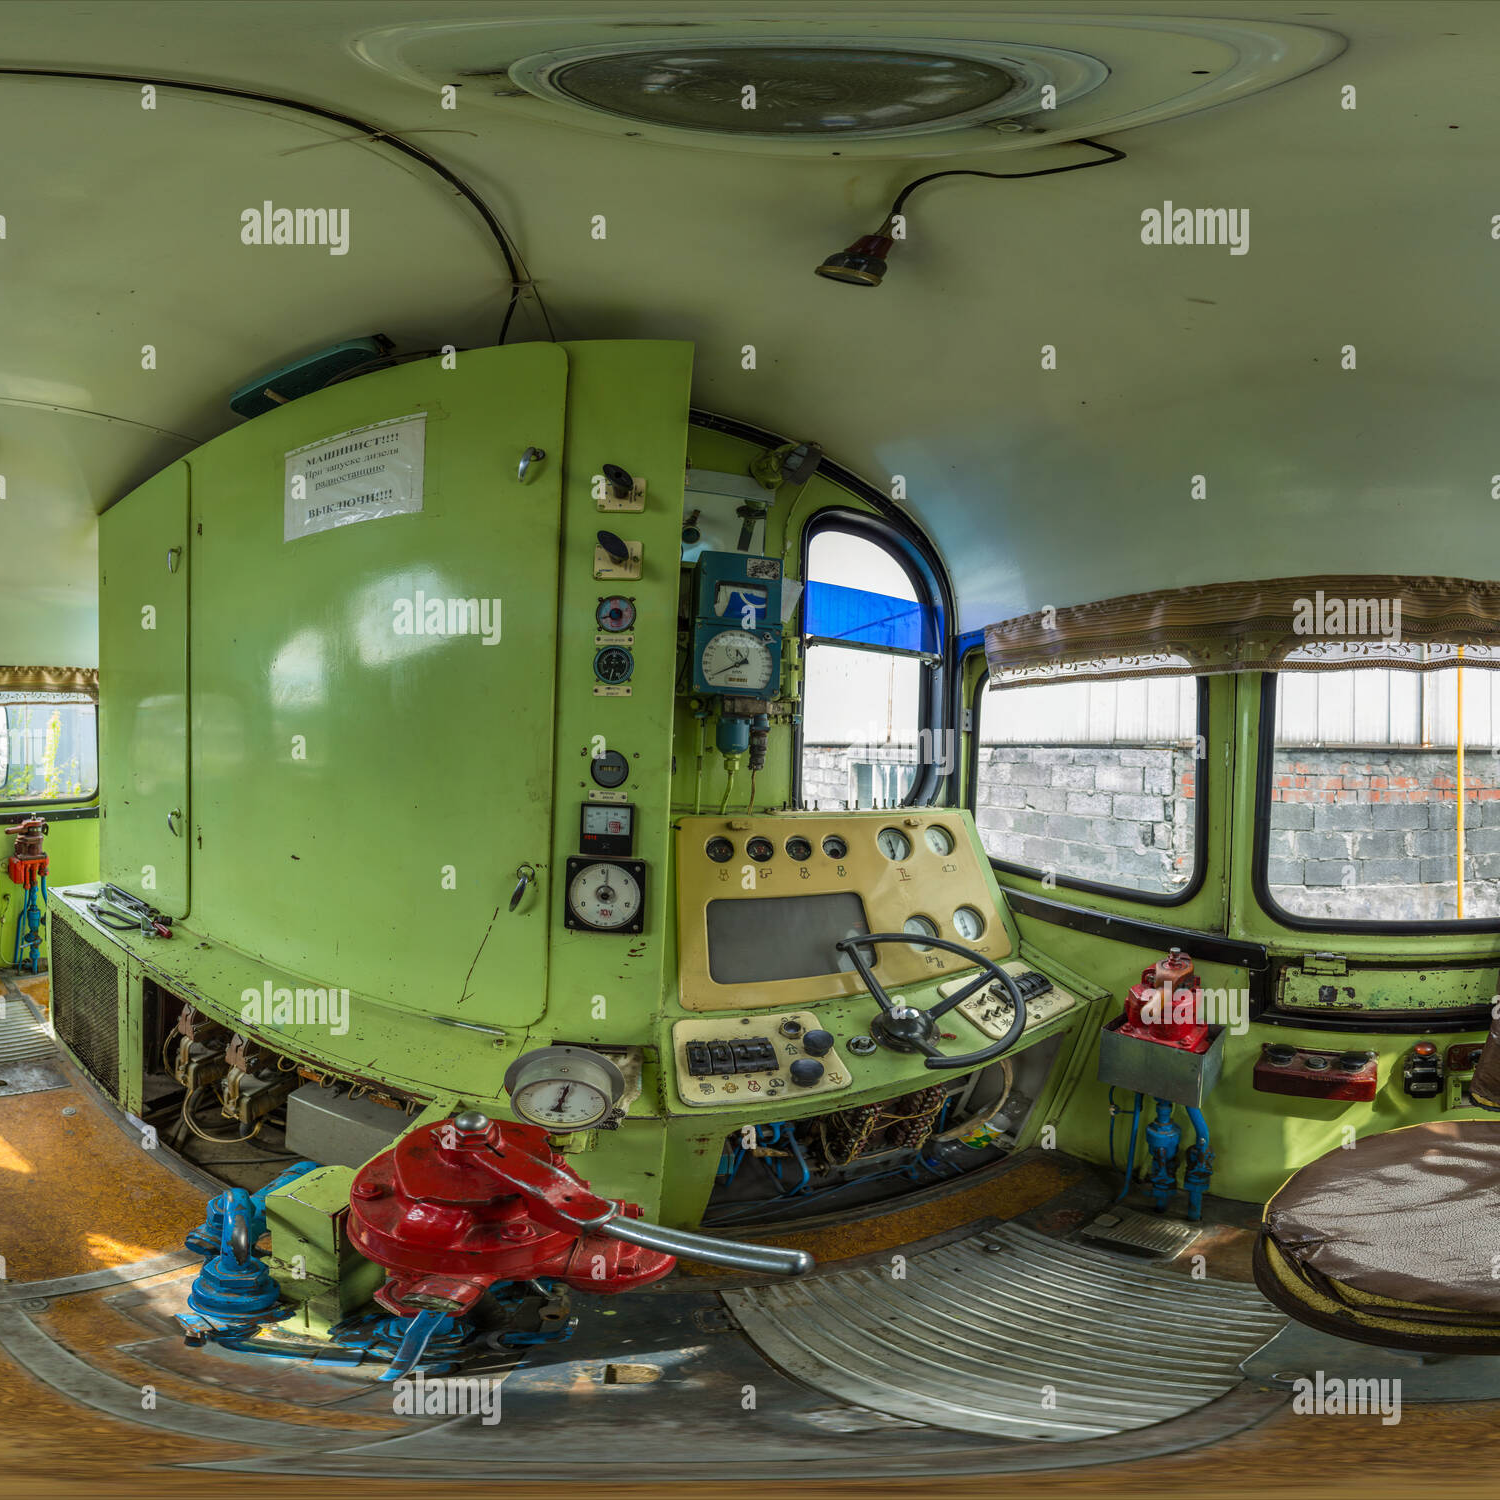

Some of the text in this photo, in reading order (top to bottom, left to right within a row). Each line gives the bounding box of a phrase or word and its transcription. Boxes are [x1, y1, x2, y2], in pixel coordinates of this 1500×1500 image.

[305, 447, 399, 480] При запуске дизеля
[306, 432, 400, 467] МАШИНИСТ!!!!
[315, 464, 386, 490] радиостанцию
[308, 488, 393, 519] ВЫКЛЮЧИ!!!!
[623, 878, 629, 886] 9
